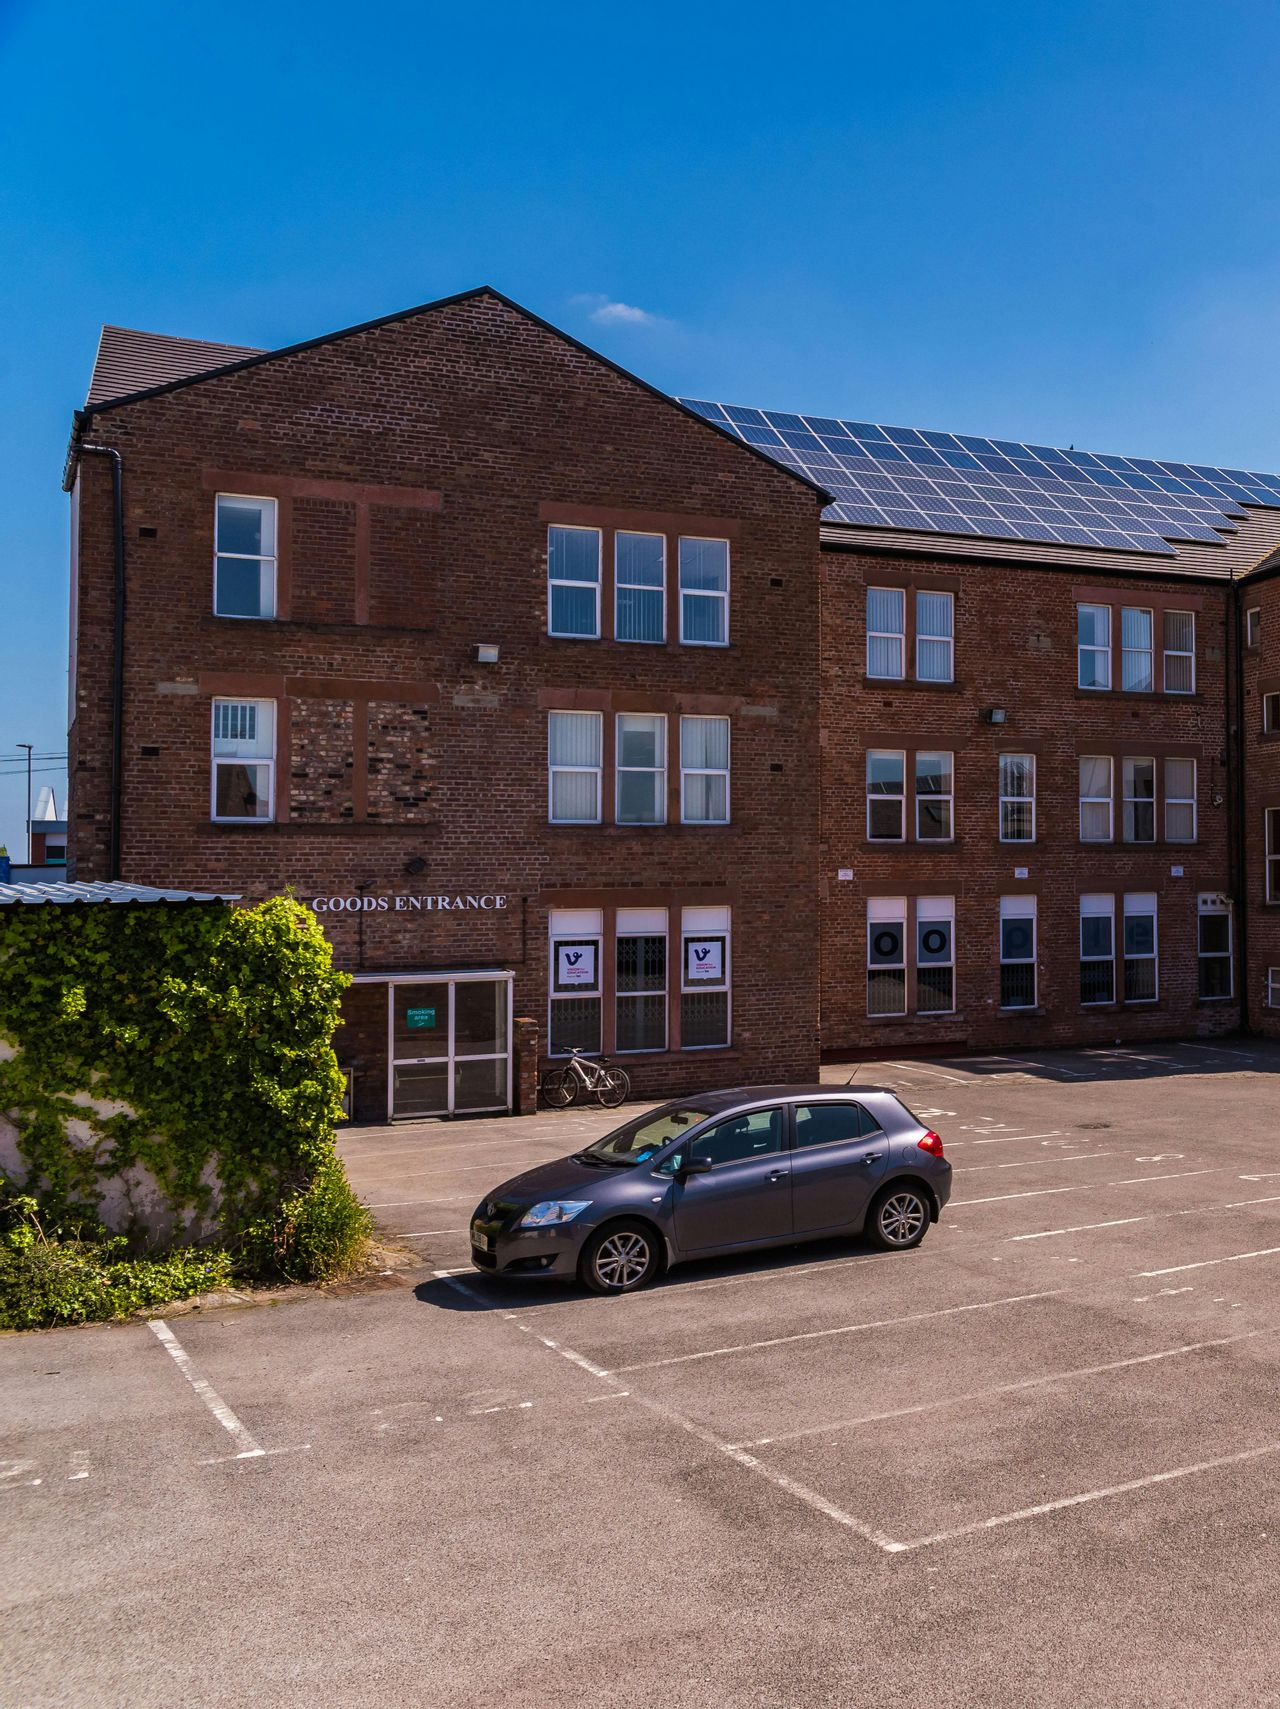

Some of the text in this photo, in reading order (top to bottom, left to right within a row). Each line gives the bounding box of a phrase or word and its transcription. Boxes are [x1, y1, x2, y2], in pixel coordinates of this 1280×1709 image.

[312, 895, 507, 912] GOODS ENTRANCE
[407, 1009, 435, 1017] Smoking
